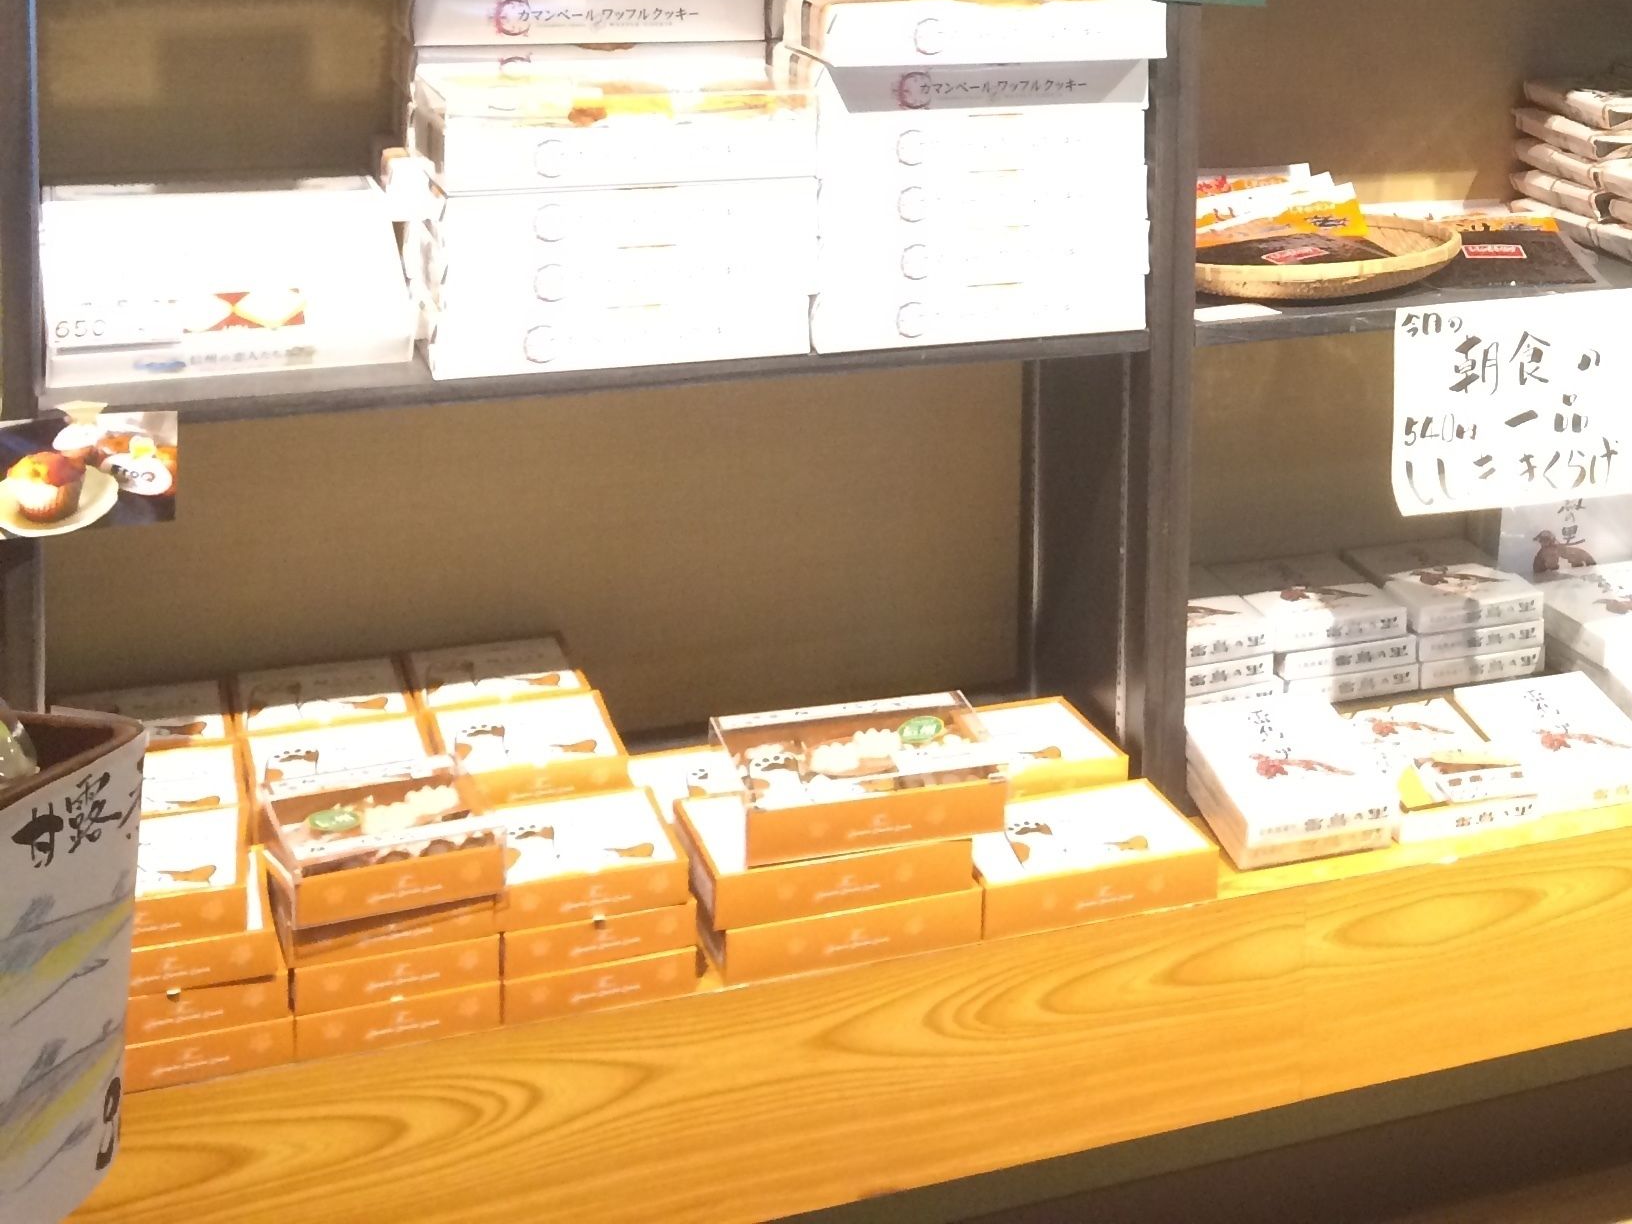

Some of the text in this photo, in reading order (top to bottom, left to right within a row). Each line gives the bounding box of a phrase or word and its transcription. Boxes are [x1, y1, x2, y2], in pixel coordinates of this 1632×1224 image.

[519, 7, 595, 22] カマンベール
[11, 759, 143, 868] 甘露
